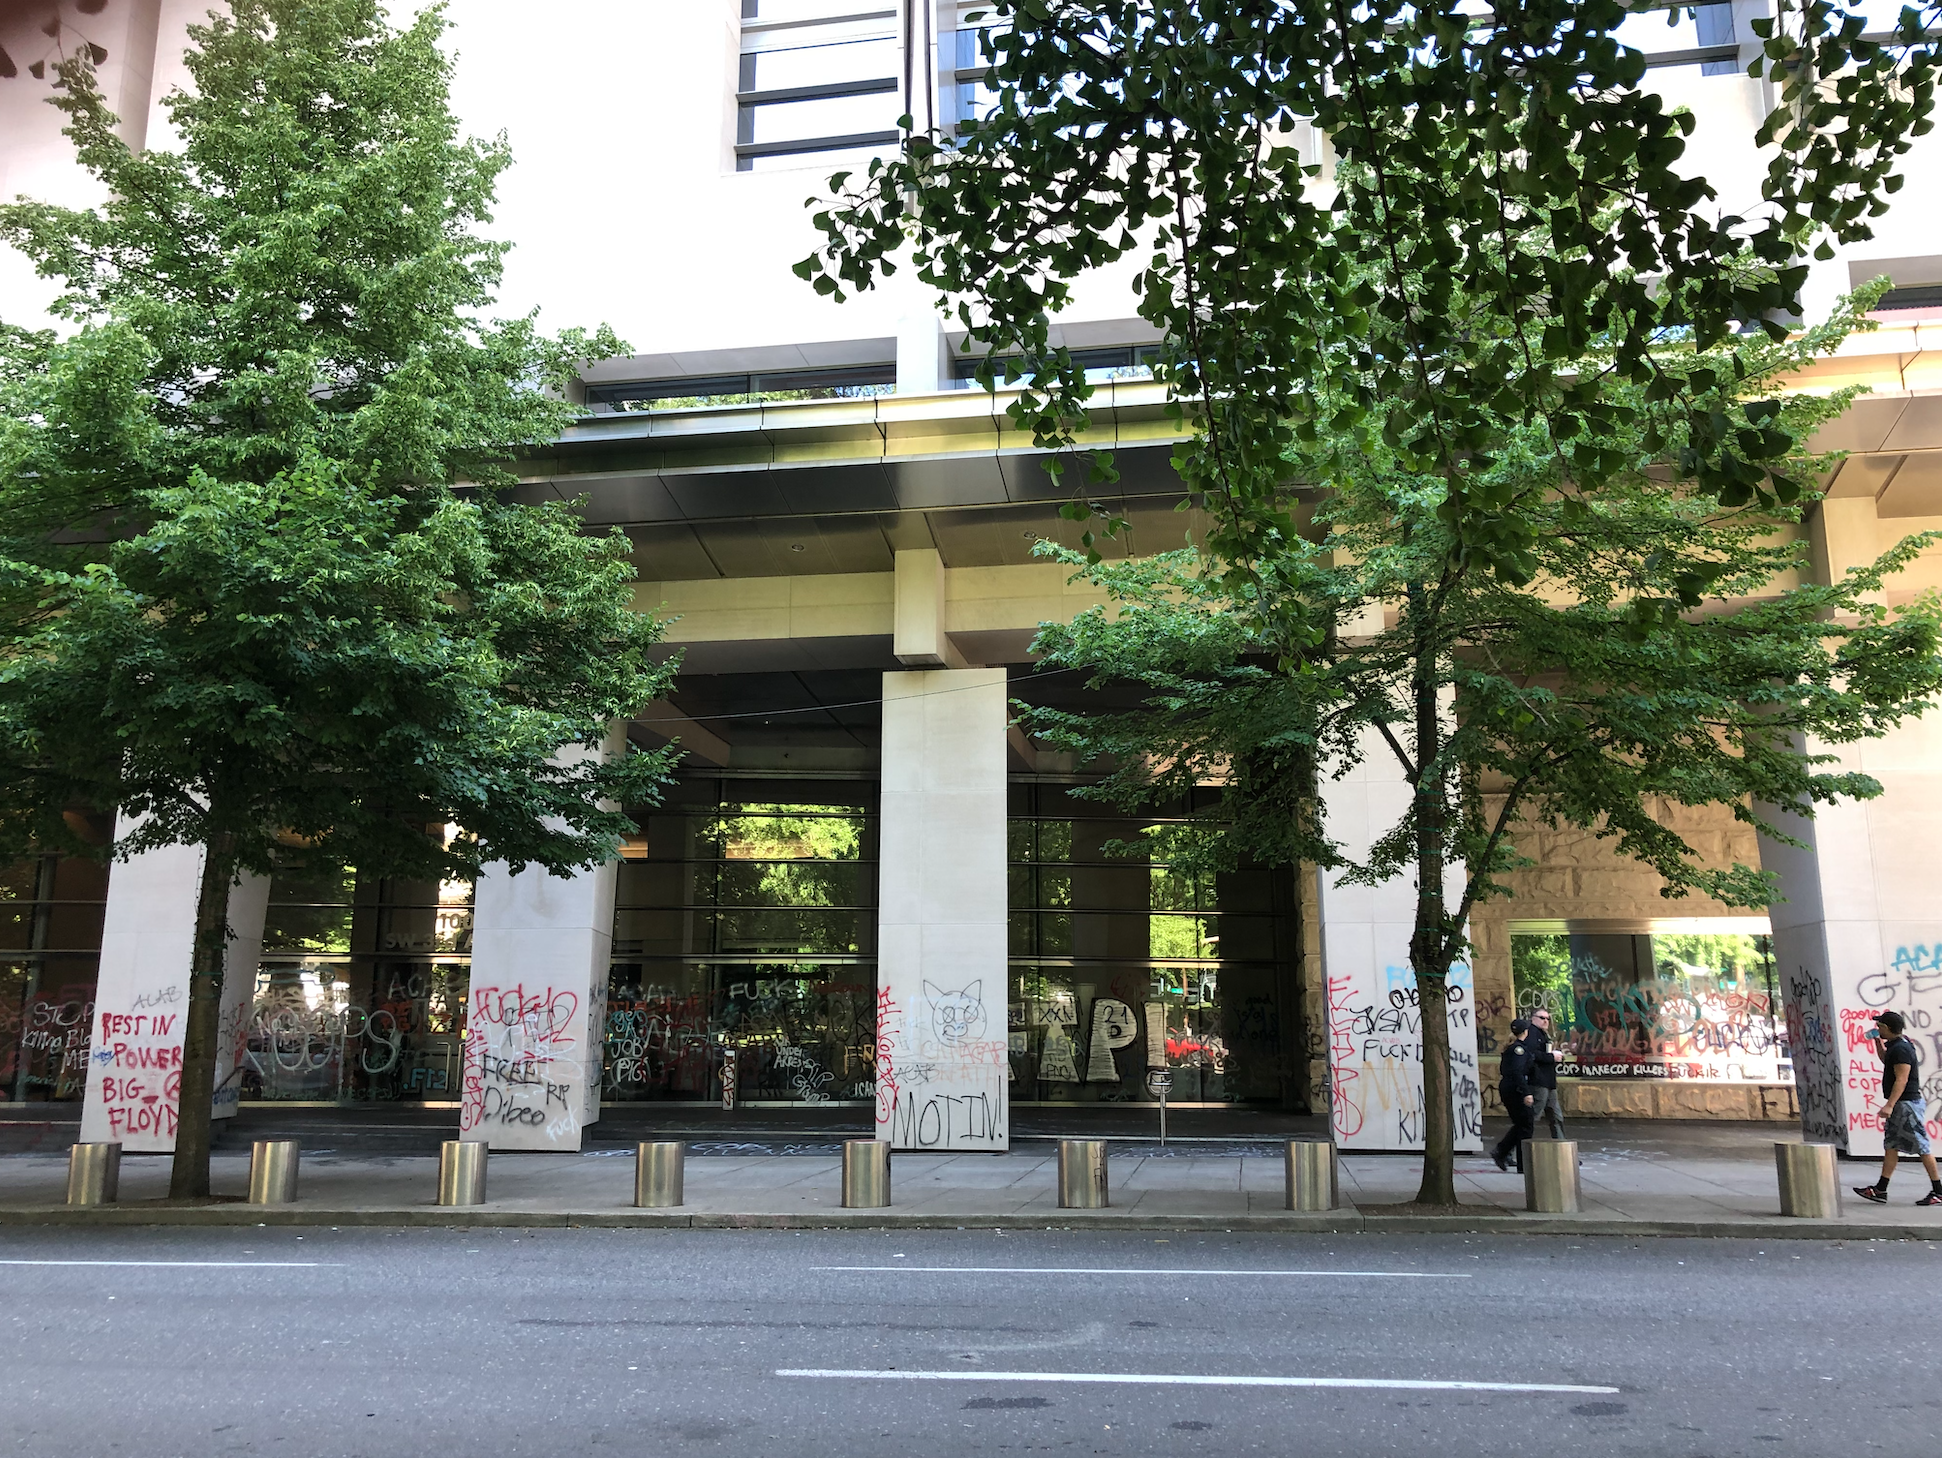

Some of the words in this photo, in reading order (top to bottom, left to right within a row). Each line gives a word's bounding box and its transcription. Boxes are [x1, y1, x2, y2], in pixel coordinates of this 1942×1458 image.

[385, 932, 416, 949] SW
[33, 1000, 95, 1026] STOP
[1103, 1005, 1129, 1025] 21
[102, 1012, 147, 1045] REST
[152, 1014, 176, 1036] IN
[114, 1043, 181, 1070] POWER
[610, 1038, 643, 1058] JOB
[1555, 1063, 1579, 1074] COPS
[1849, 1059, 1883, 1075] ALL
[103, 1077, 144, 1104] BIG
[108, 1104, 179, 1137] FLOYD
